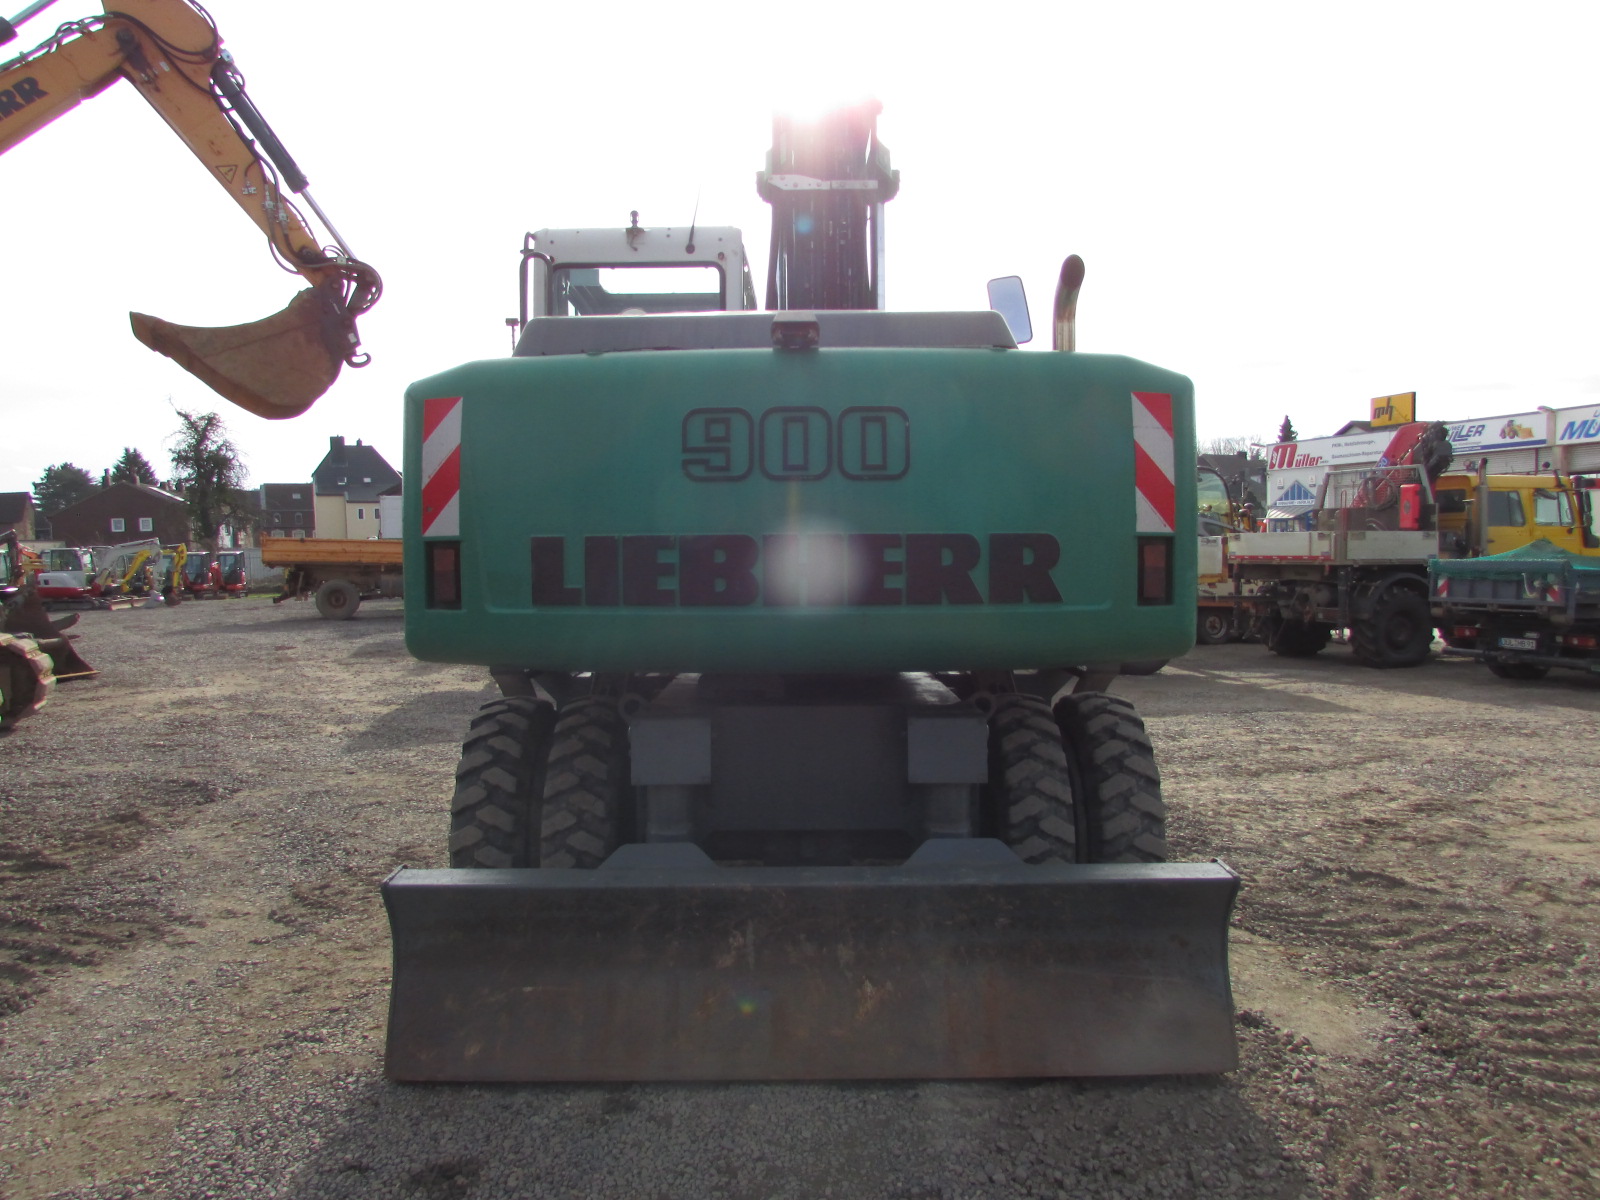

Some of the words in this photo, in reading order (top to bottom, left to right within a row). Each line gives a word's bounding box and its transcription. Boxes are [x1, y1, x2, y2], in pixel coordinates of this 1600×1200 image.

[0, 77, 50, 122] RR
[682, 406, 910, 482] 900
[1448, 424, 1485, 442] LLER
[1269, 444, 1322, 469] Müller
[531, 533, 1063, 606] LIEBHERR
